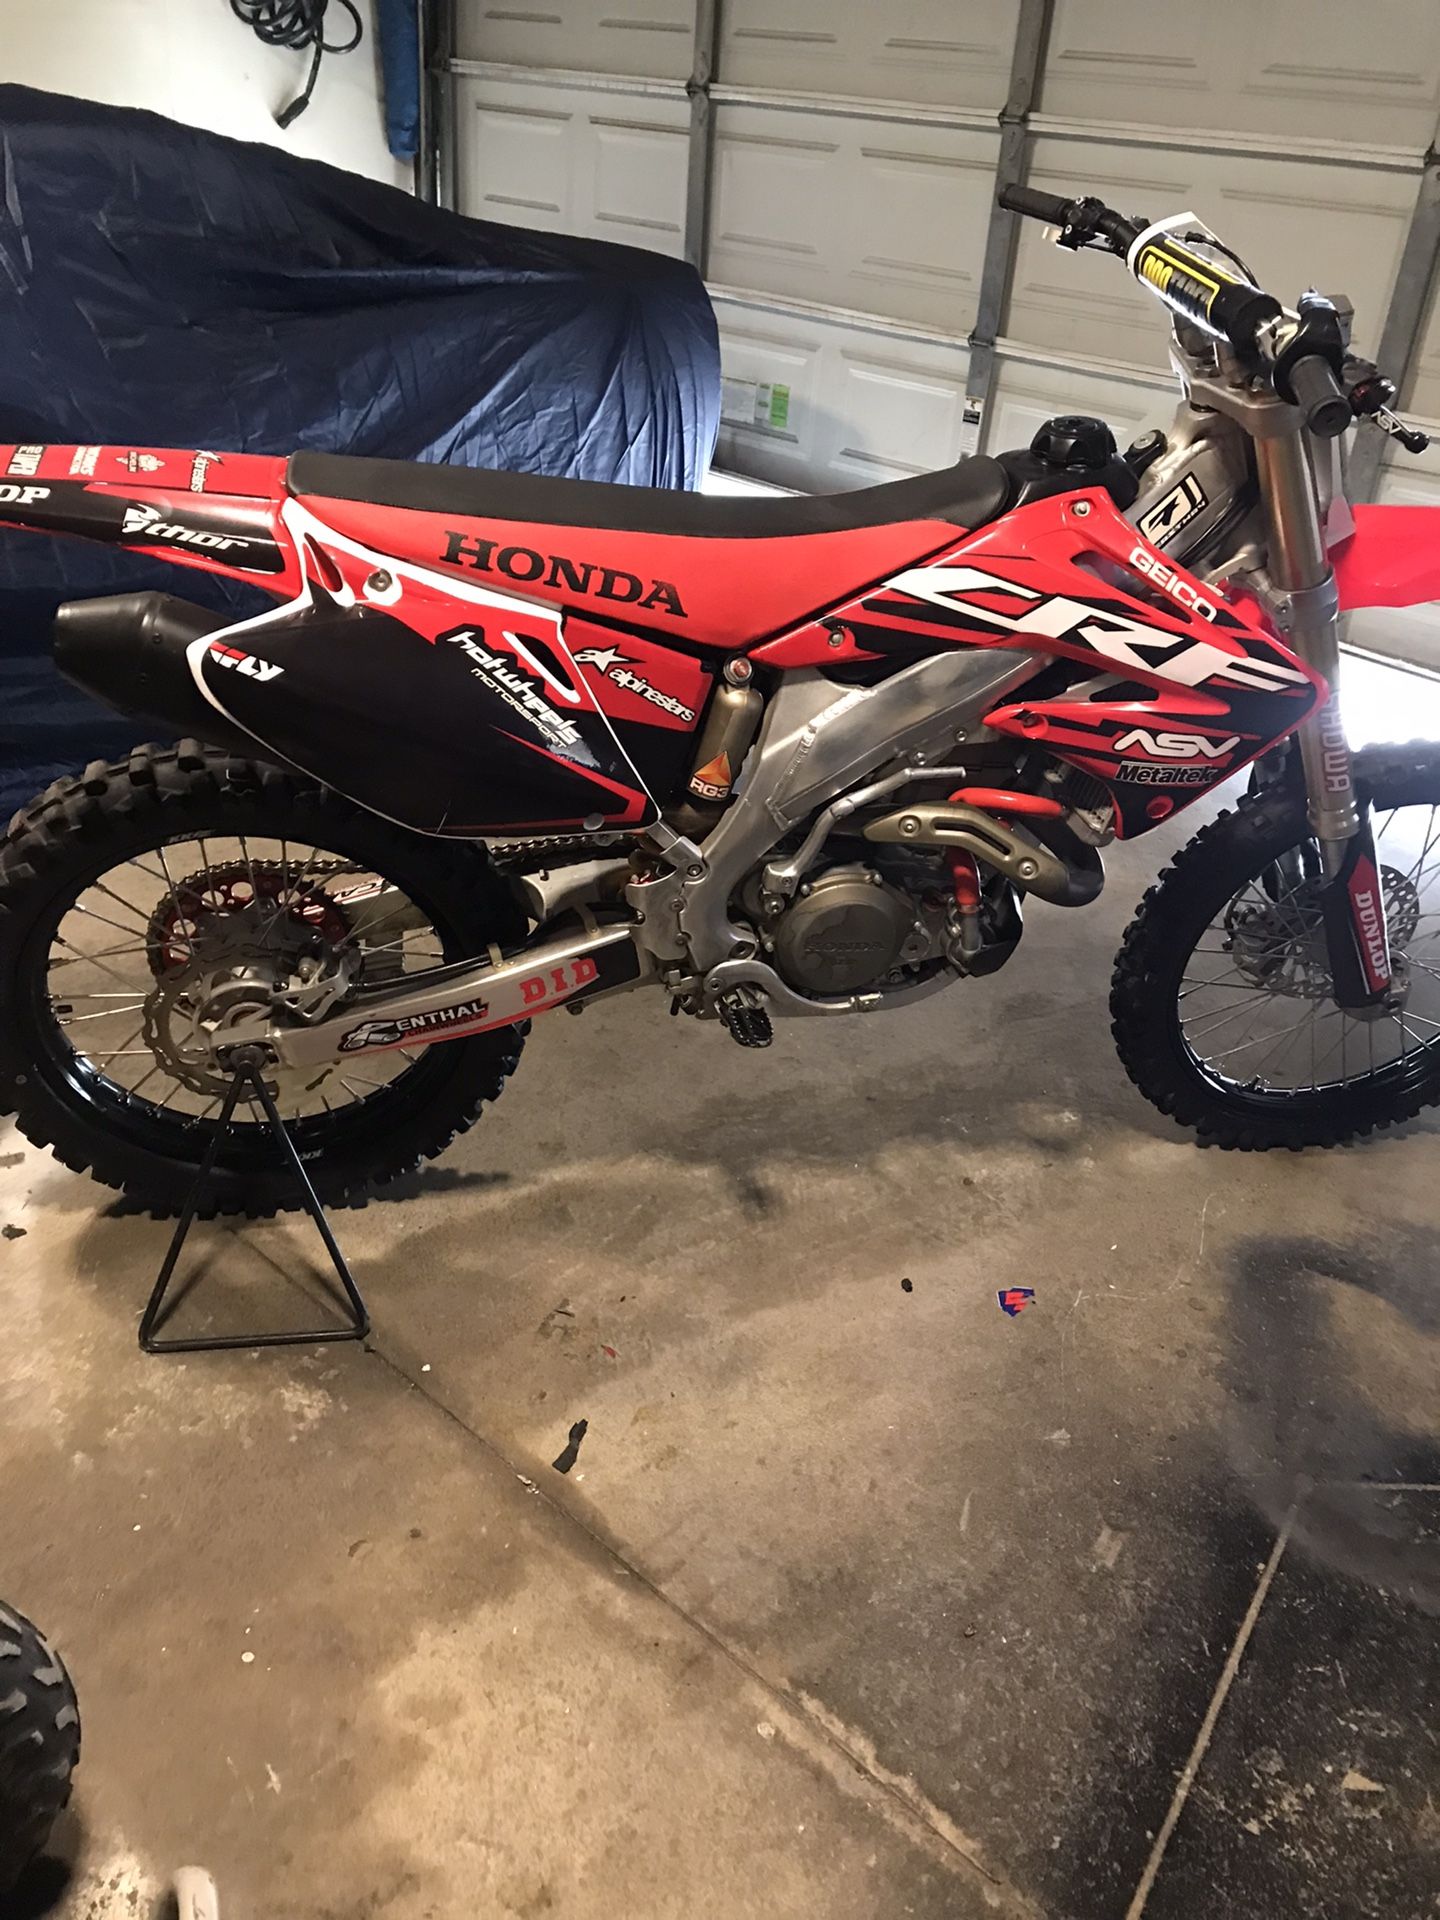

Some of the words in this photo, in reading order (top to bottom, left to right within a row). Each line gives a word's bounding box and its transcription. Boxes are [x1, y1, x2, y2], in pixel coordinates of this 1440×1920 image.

[145, 522, 249, 550] thor
[439, 530, 688, 618] HONDA
[1129, 546, 1217, 623] GEICO
[882, 566, 1311, 691] CRF
[471, 667, 567, 748] MOTORSPORT
[609, 668, 695, 722] alpinestars
[1114, 729, 1240, 758] ASV
[1116, 763, 1218, 785] Metaltek
[690, 776, 730, 798] RG3
[1355, 890, 1389, 980] DUNLOP
